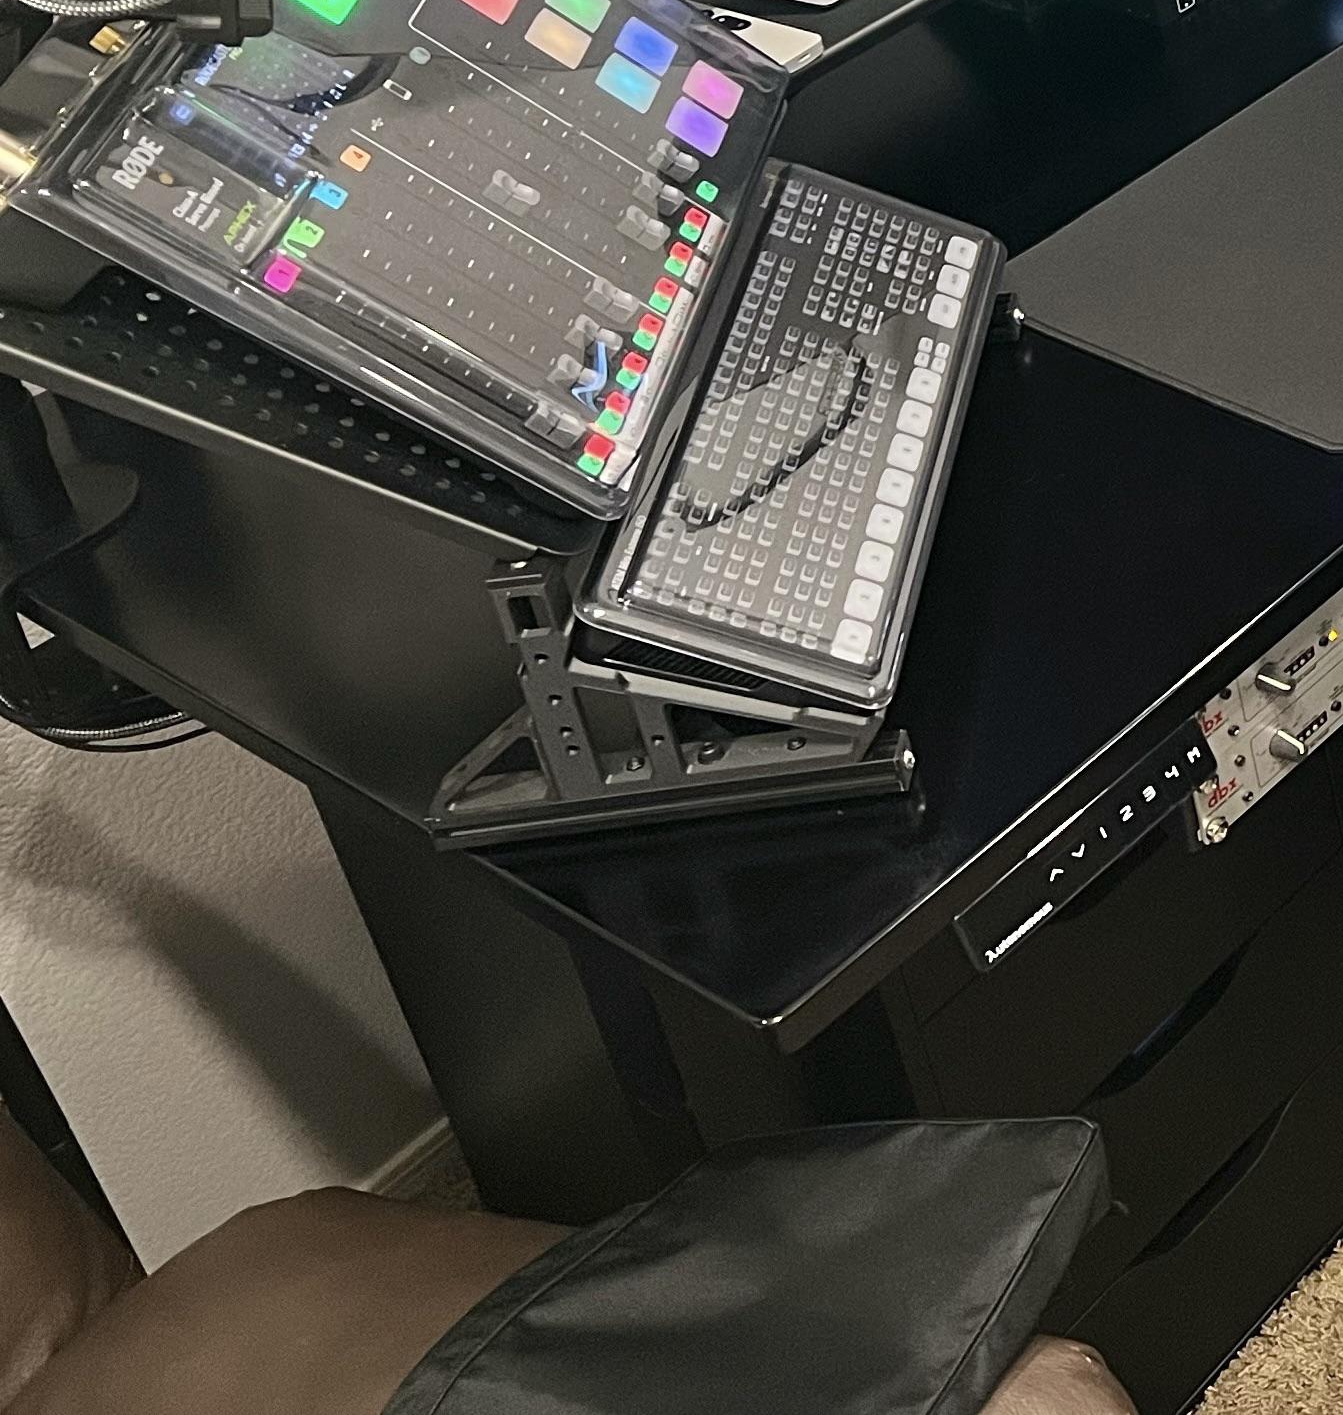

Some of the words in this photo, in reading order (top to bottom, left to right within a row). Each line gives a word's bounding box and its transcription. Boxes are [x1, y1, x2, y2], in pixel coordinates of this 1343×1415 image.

[112, 135, 164, 191] RØDE
[1119, 804, 1134, 822] 2
[1142, 785, 1157, 803] 3
[1164, 765, 1180, 779] 4
[1186, 746, 1201, 764] M
[1207, 776, 1237, 809] dbx
